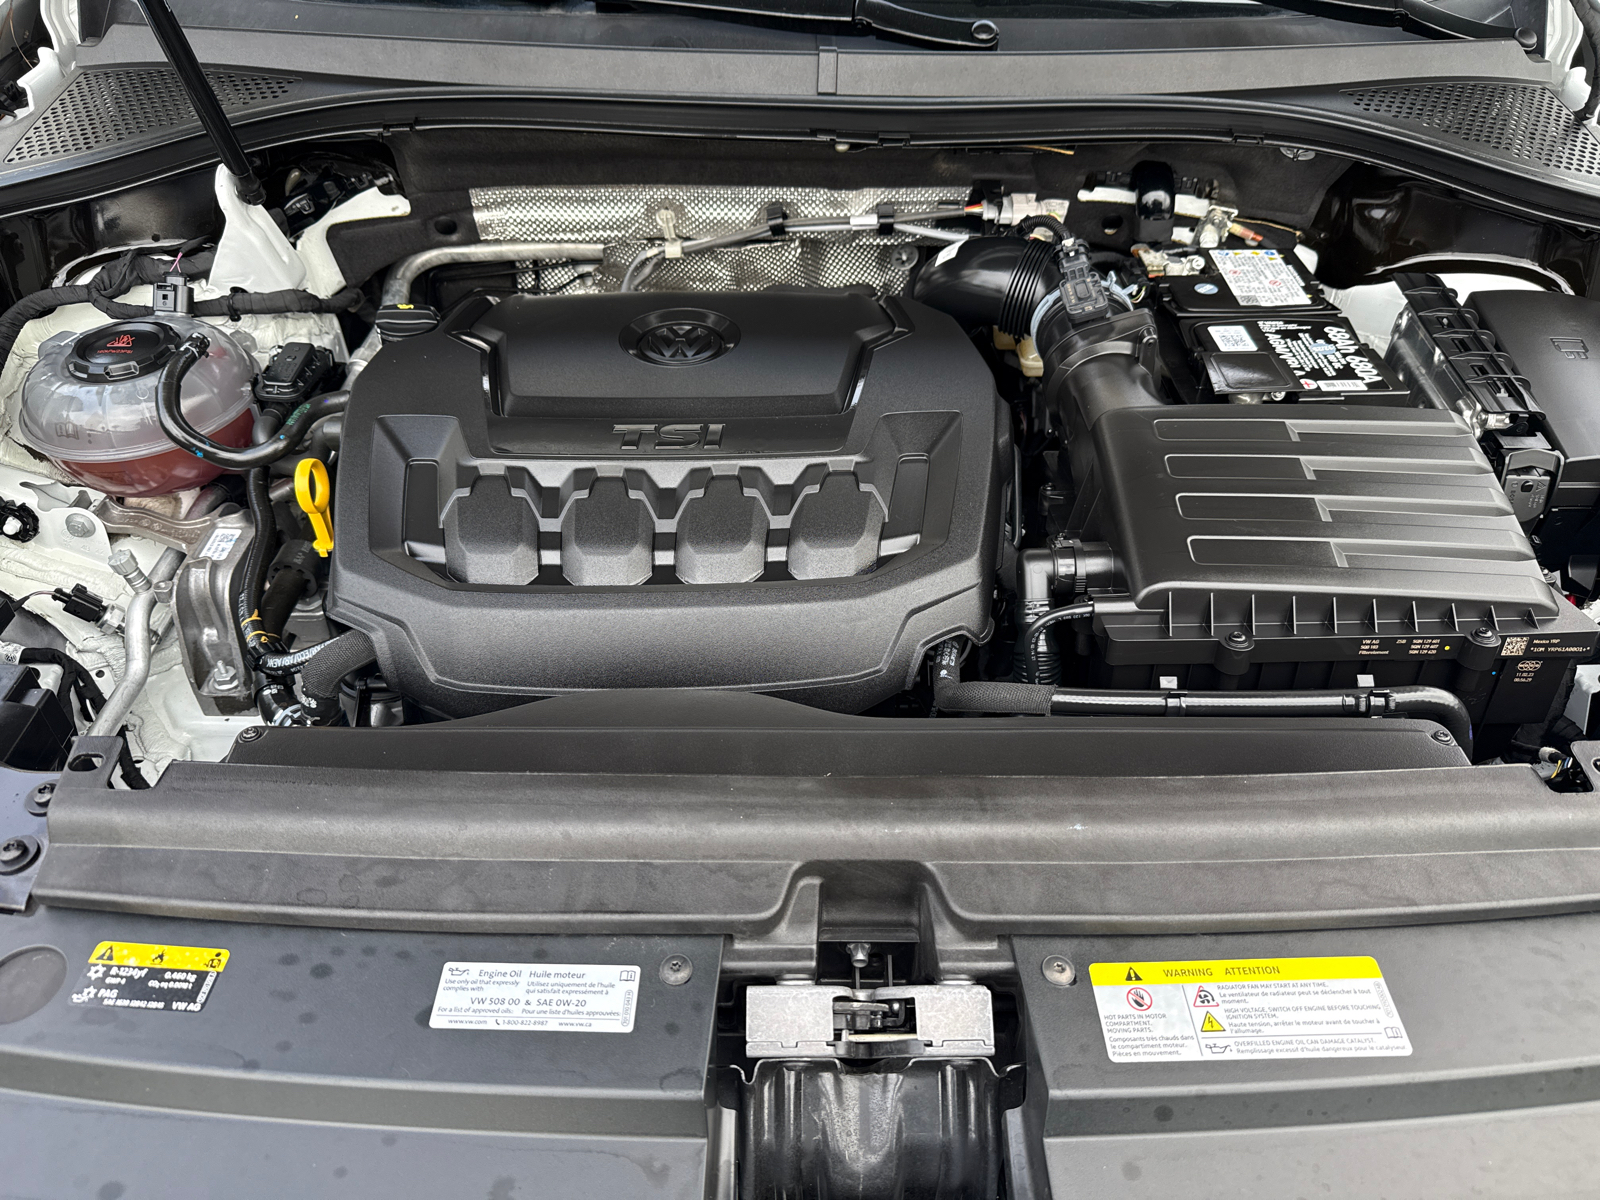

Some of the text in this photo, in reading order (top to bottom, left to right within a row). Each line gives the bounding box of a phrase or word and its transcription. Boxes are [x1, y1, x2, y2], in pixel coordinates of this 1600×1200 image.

[642, 324, 719, 361] VW
[1324, 326, 1359, 353] 68Ah
[1346, 356, 1383, 383] 680A
[613, 424, 725, 449] TSI
[187, 972, 197, 982] kg
[479, 970, 507, 979] Engine
[1163, 966, 1280, 977] WARNING ATTENTION
[98, 988, 118, 998] PAG
[172, 1001, 201, 1011] VW AG
